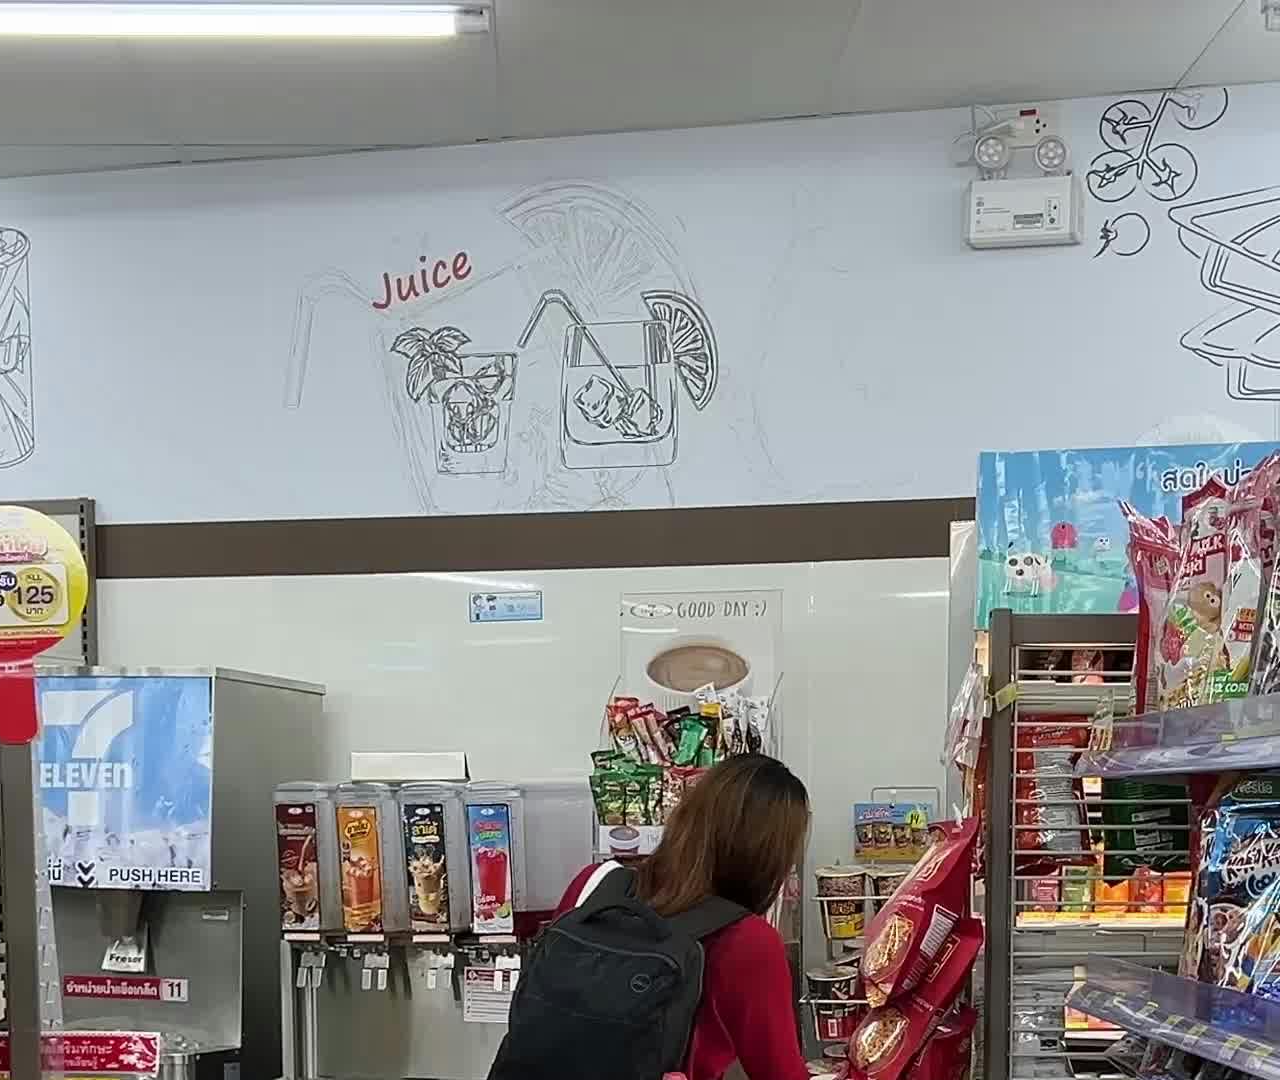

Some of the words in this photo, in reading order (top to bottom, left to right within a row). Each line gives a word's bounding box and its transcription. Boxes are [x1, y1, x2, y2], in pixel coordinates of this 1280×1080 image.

[372, 250, 473, 310] Juice
[13, 585, 55, 605] 125
[676, 600, 716, 619] GOOD
[723, 600, 749, 617] DAY
[109, 868, 153, 884] PUSH
[158, 868, 201, 884] HERE
[166, 980, 184, 998] 11
